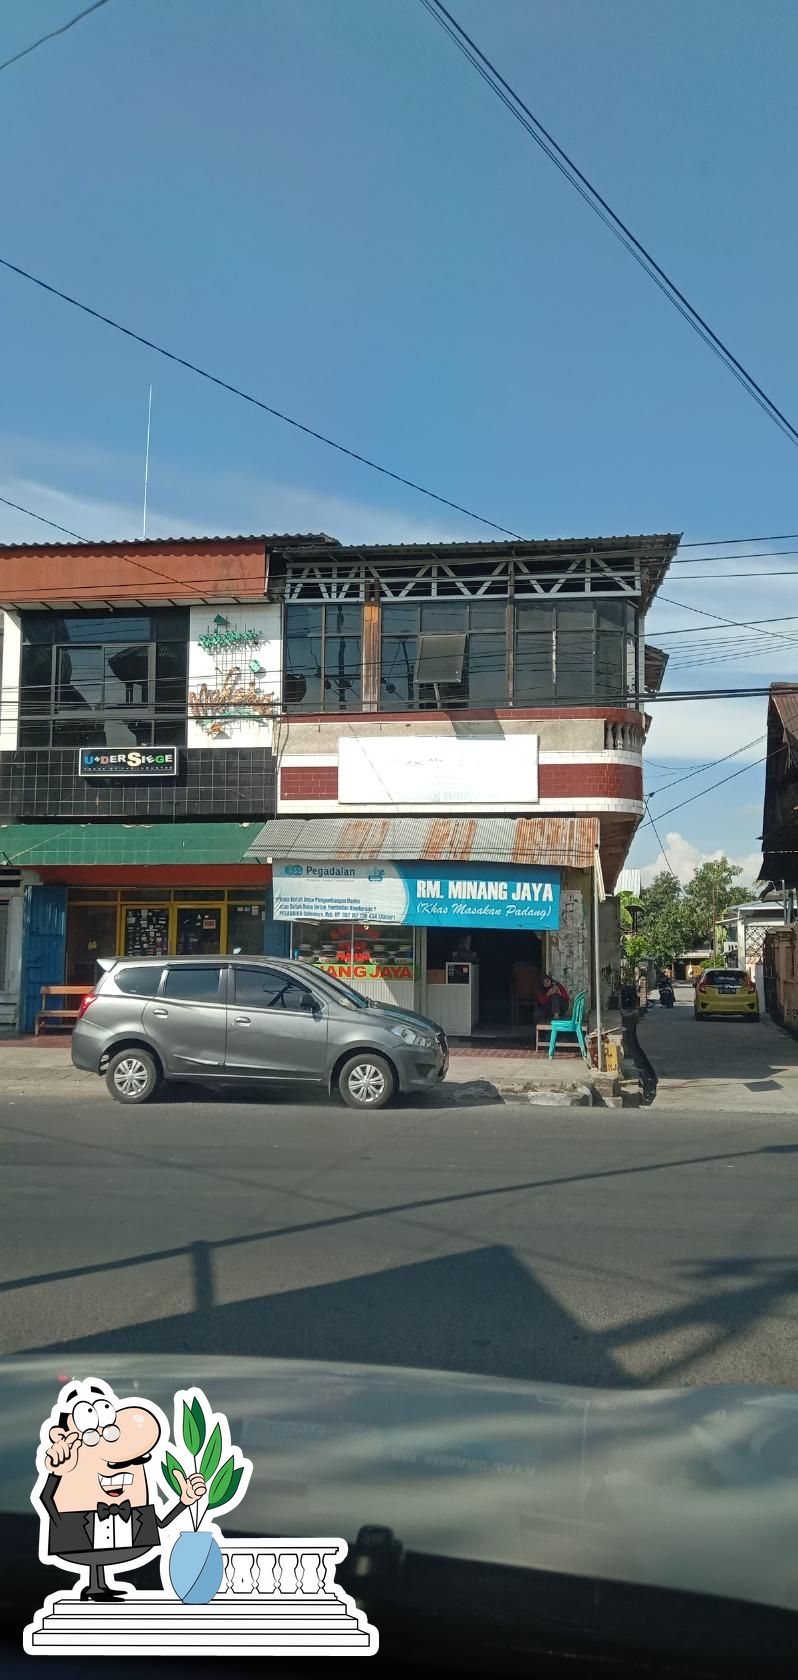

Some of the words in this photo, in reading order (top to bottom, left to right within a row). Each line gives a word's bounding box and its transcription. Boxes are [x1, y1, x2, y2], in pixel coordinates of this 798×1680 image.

[306, 865, 356, 877] Pegadaian
[416, 879, 443, 899] RM.
[448, 880, 508, 900] MINANG
[511, 882, 554, 902] JAYA
[416, 902, 449, 914] (Khas
[451, 902, 502, 916] Masakan
[505, 904, 552, 920] Padang)
[370, 966, 411, 978] JAYA
